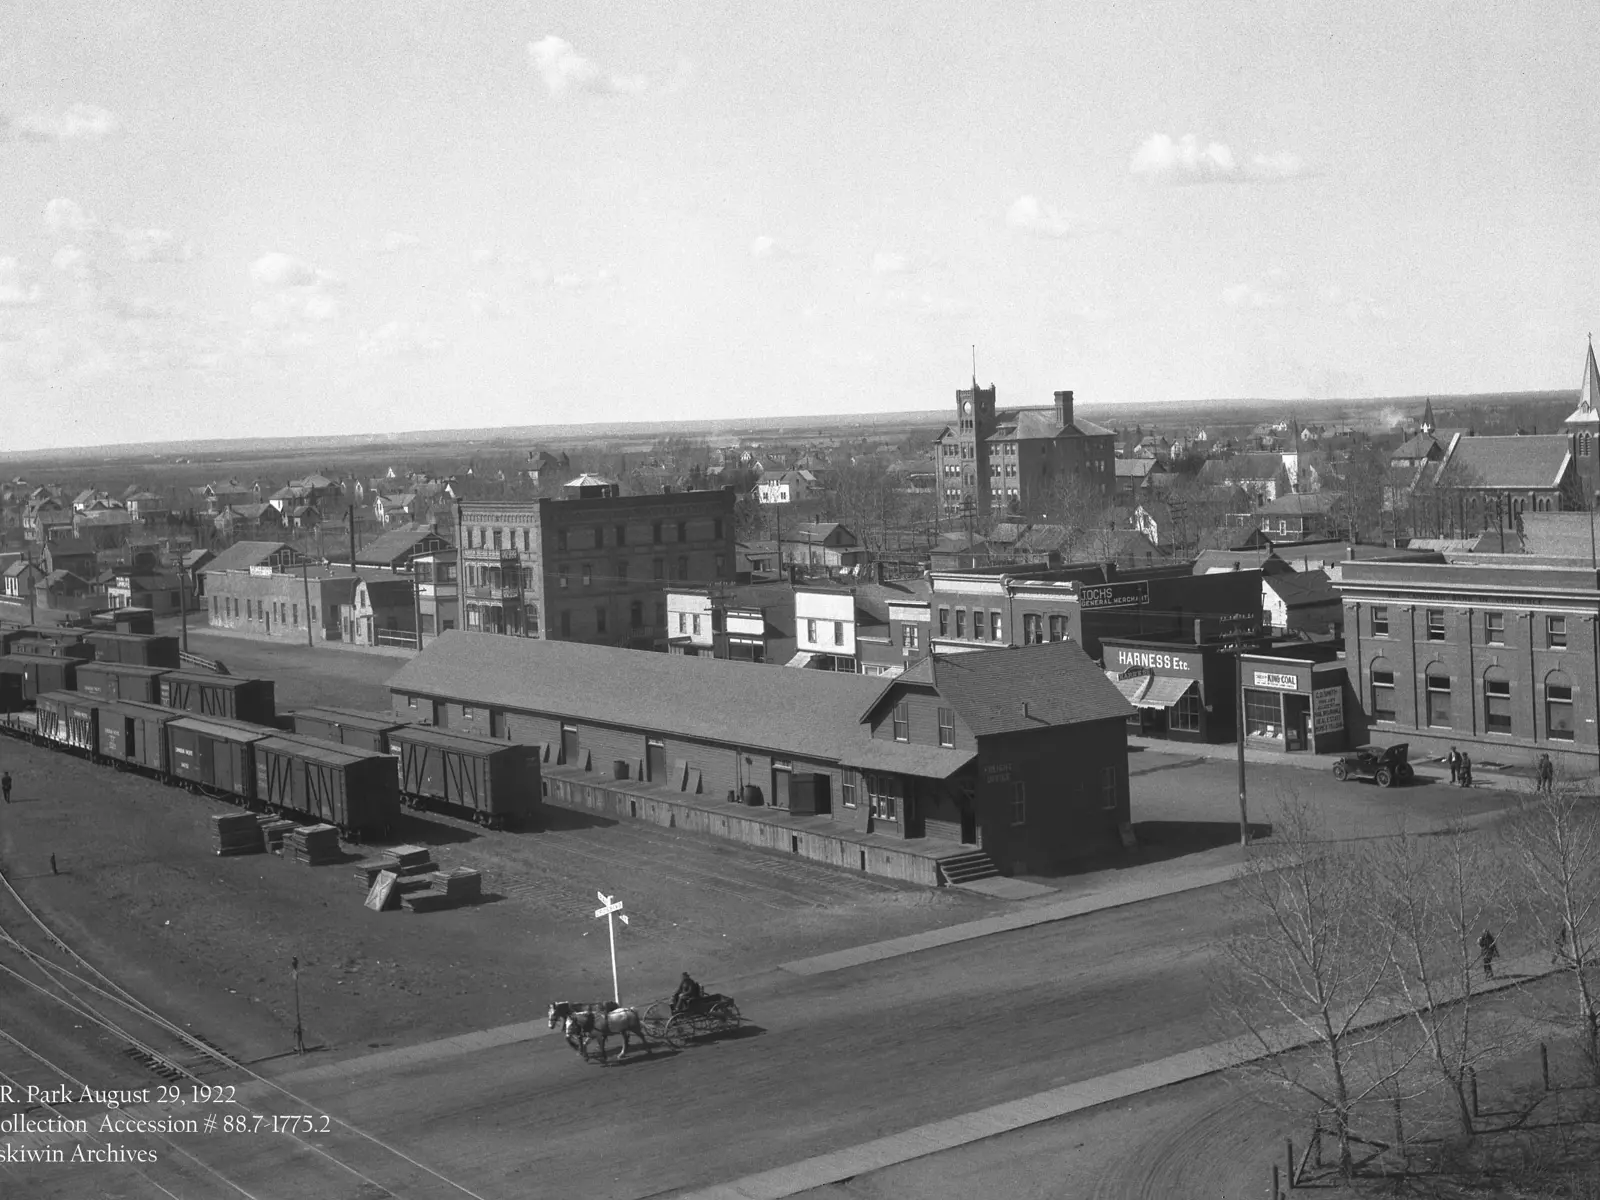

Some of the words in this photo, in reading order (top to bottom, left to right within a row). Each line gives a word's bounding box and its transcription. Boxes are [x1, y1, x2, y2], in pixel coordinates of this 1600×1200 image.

[1081, 599, 1112, 607] GENERAL
[1118, 651, 1171, 669] HARNESS
[1173, 657, 1190, 671] Etc.
[1281, 676, 1296, 685] COAL
